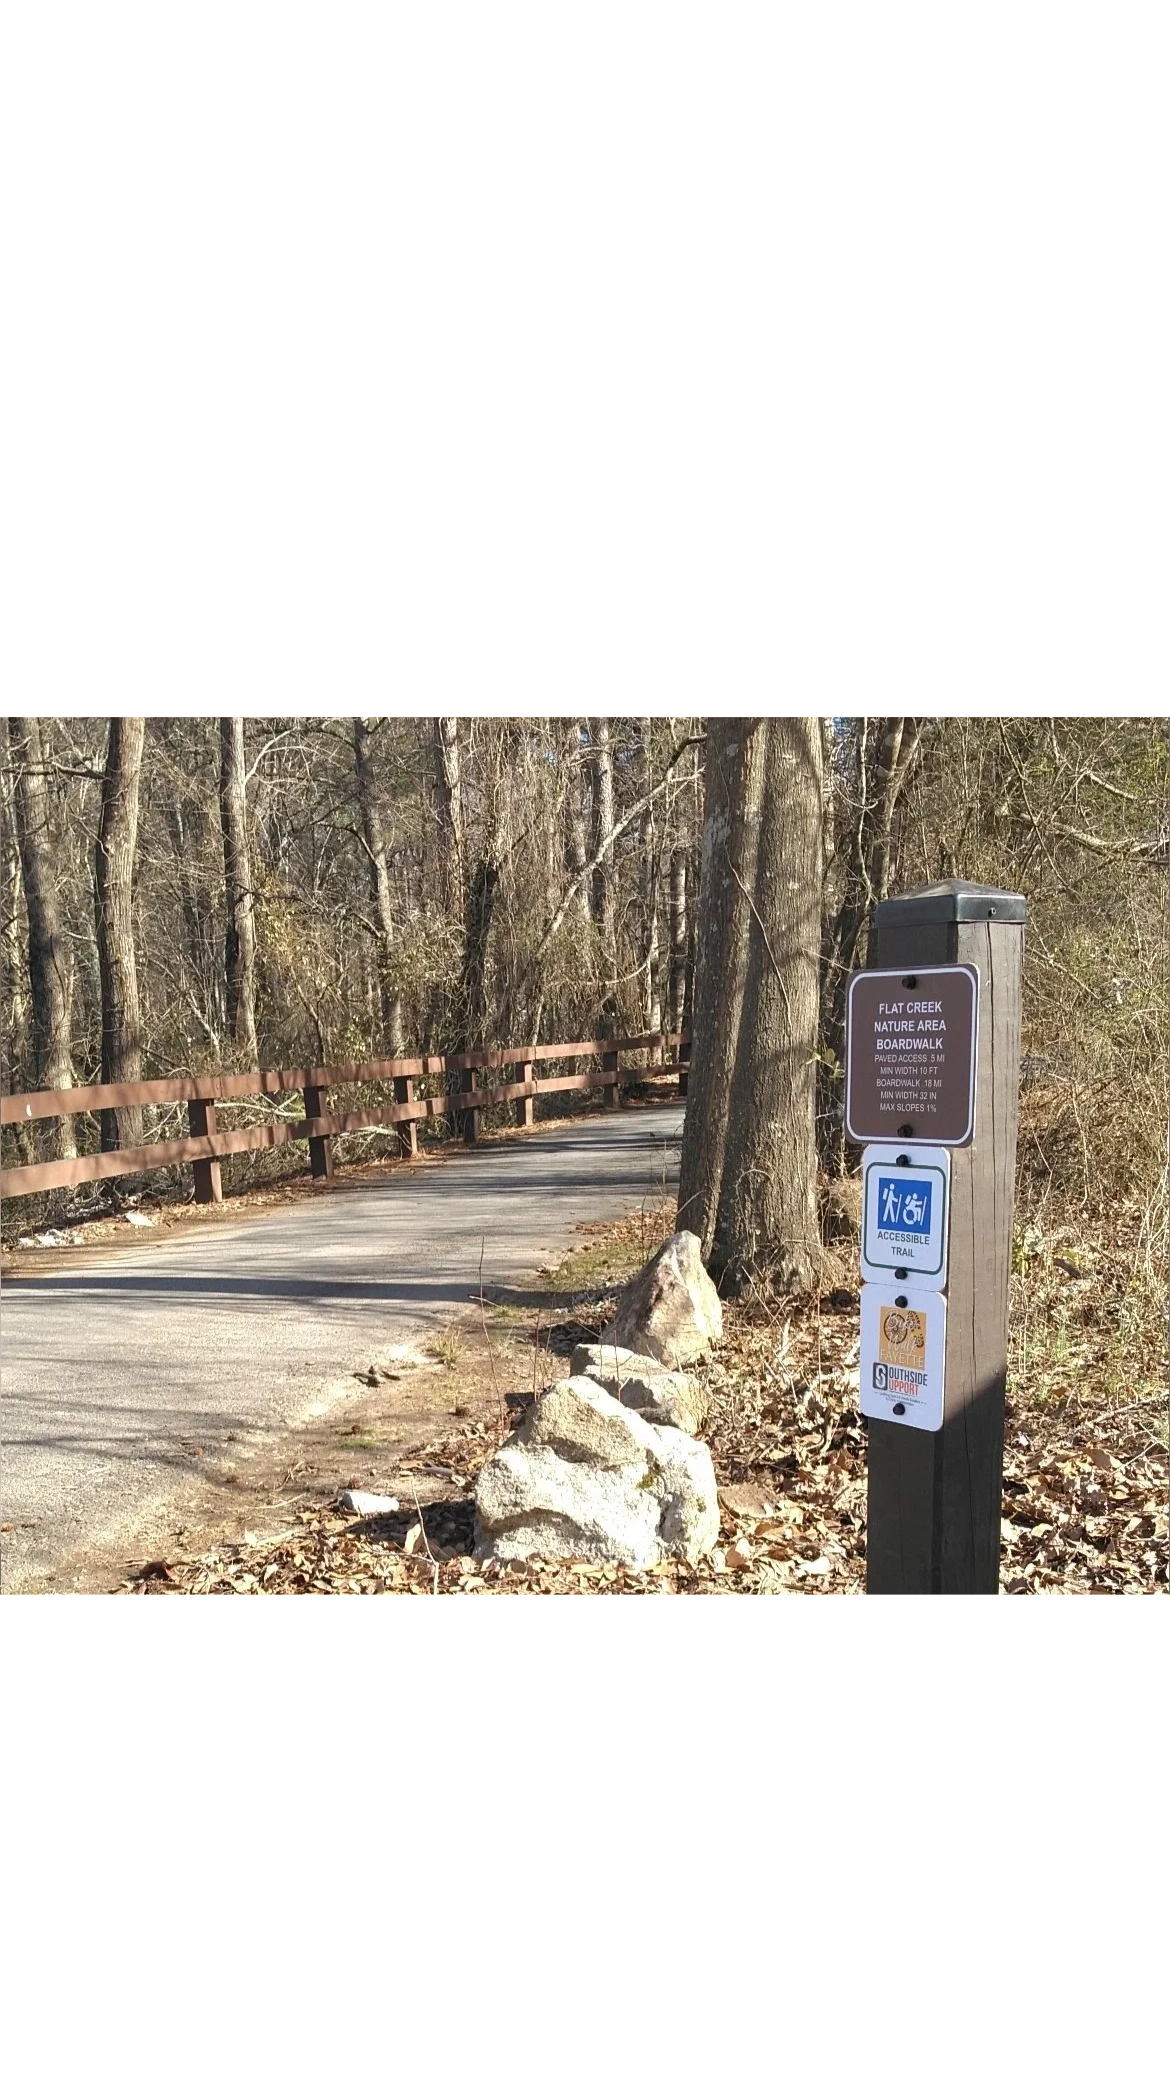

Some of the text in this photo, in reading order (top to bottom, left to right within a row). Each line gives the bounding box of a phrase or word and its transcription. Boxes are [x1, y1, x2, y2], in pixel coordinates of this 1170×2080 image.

[879, 1001, 942, 1014] FLAT CREEK
[874, 1020, 946, 1032] NATURE AREA
[876, 1038, 943, 1050] BOARDWALK
[874, 1054, 897, 1063] PAVED
[898, 1054, 927, 1063] ACCESS
[936, 1054, 945, 1062] MI
[880, 1066, 938, 1075] MIN WIDTH 10 FT
[876, 1079, 921, 1087] BOARDWALK
[933, 1079, 942, 1088] MI
[880, 1091, 937, 1100] MIN WIDTH 32 IN
[879, 1103, 937, 1113] MAX SLOPES 1%
[877, 1231, 930, 1245] ACCESSIBLE
[891, 1246, 915, 1257] TRAIL
[880, 1348, 925, 1369] FAYETTE
